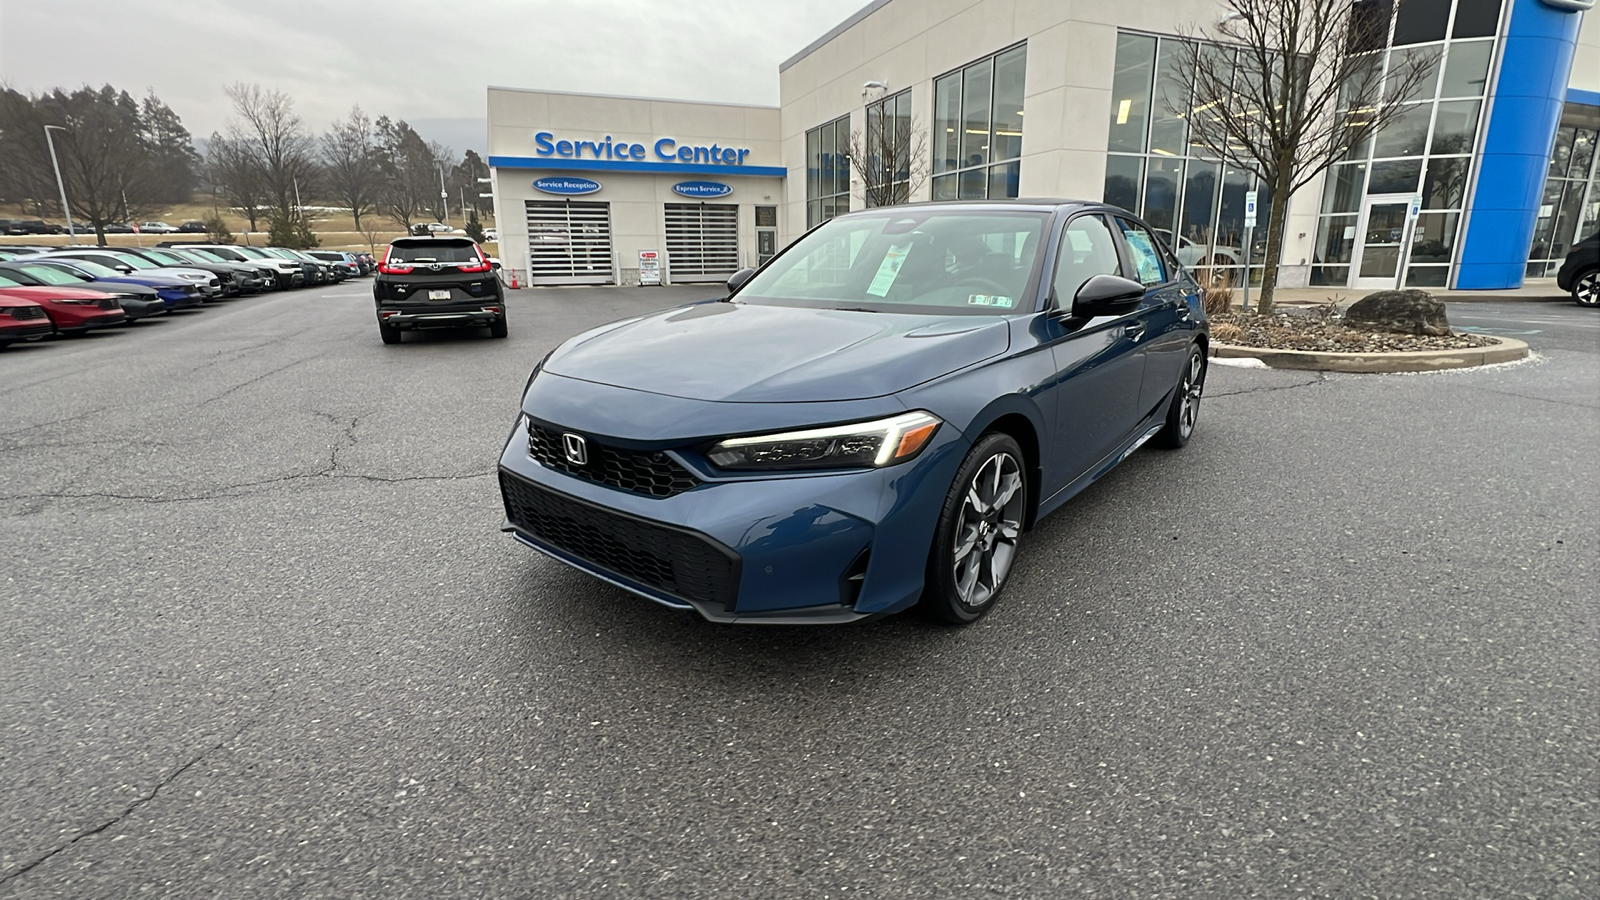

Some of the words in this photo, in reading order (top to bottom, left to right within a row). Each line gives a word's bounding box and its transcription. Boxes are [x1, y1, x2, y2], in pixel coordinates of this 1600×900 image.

[535, 132, 646, 160] Service
[654, 138, 750, 164] Center
[563, 181, 597, 190] Reception
[676, 185, 699, 193] Express
